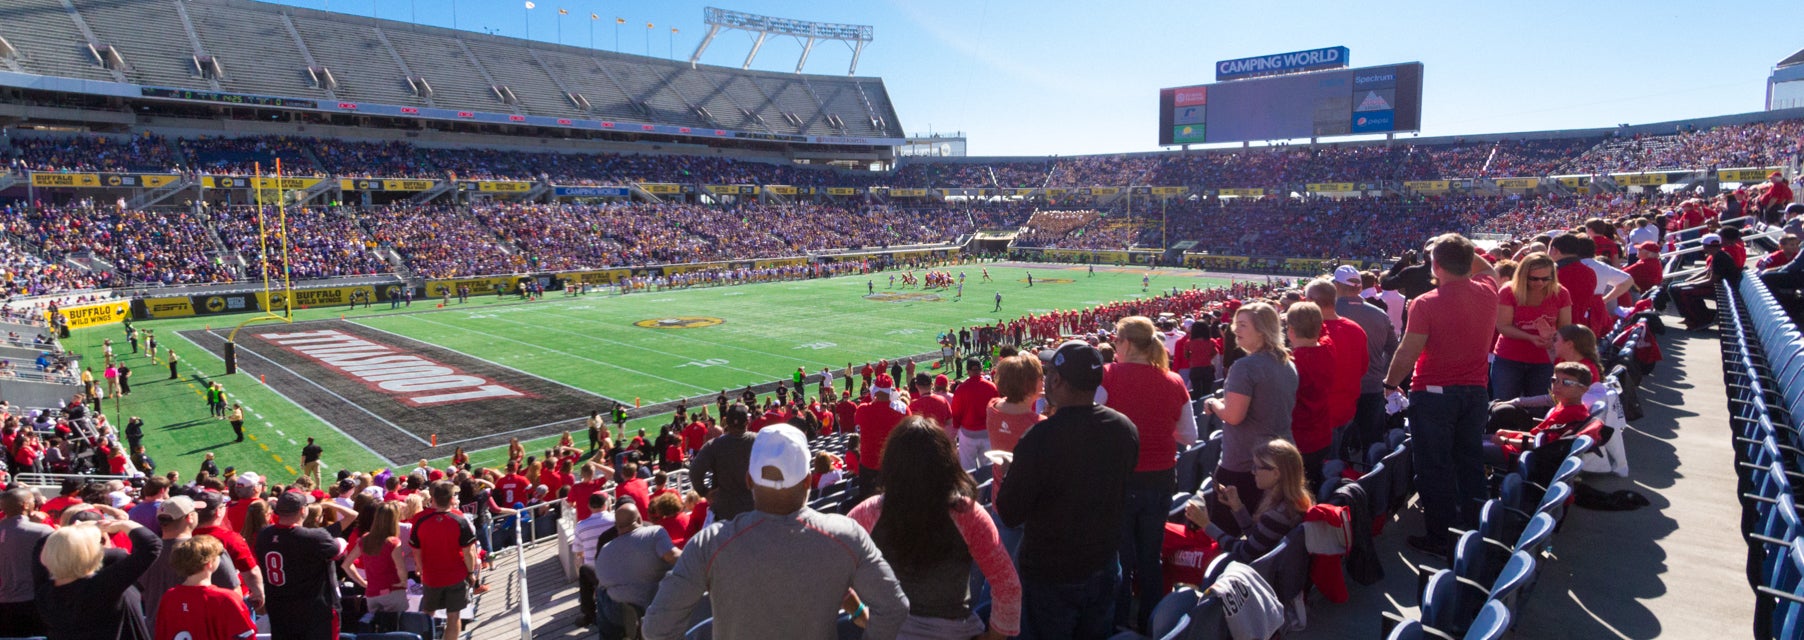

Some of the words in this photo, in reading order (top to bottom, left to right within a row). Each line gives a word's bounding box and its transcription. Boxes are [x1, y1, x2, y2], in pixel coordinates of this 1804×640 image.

[1219, 55, 1281, 74] CAMPING
[1283, 49, 1339, 67] WORLD
[1355, 74, 1394, 84] Spectrum
[1367, 116, 1389, 125] pepsi
[565, 187, 597, 195] CAMPING
[598, 187, 620, 195] WORLD
[296, 289, 341, 299] BUFFALO
[69, 305, 111, 320] BUFFALO
[153, 302, 188, 312] ESPN
[70, 317, 89, 326] WILD
[90, 314, 112, 323] WINGS
[259, 329, 526, 404] LOUISVILLE
[265, 551, 286, 587] 8
